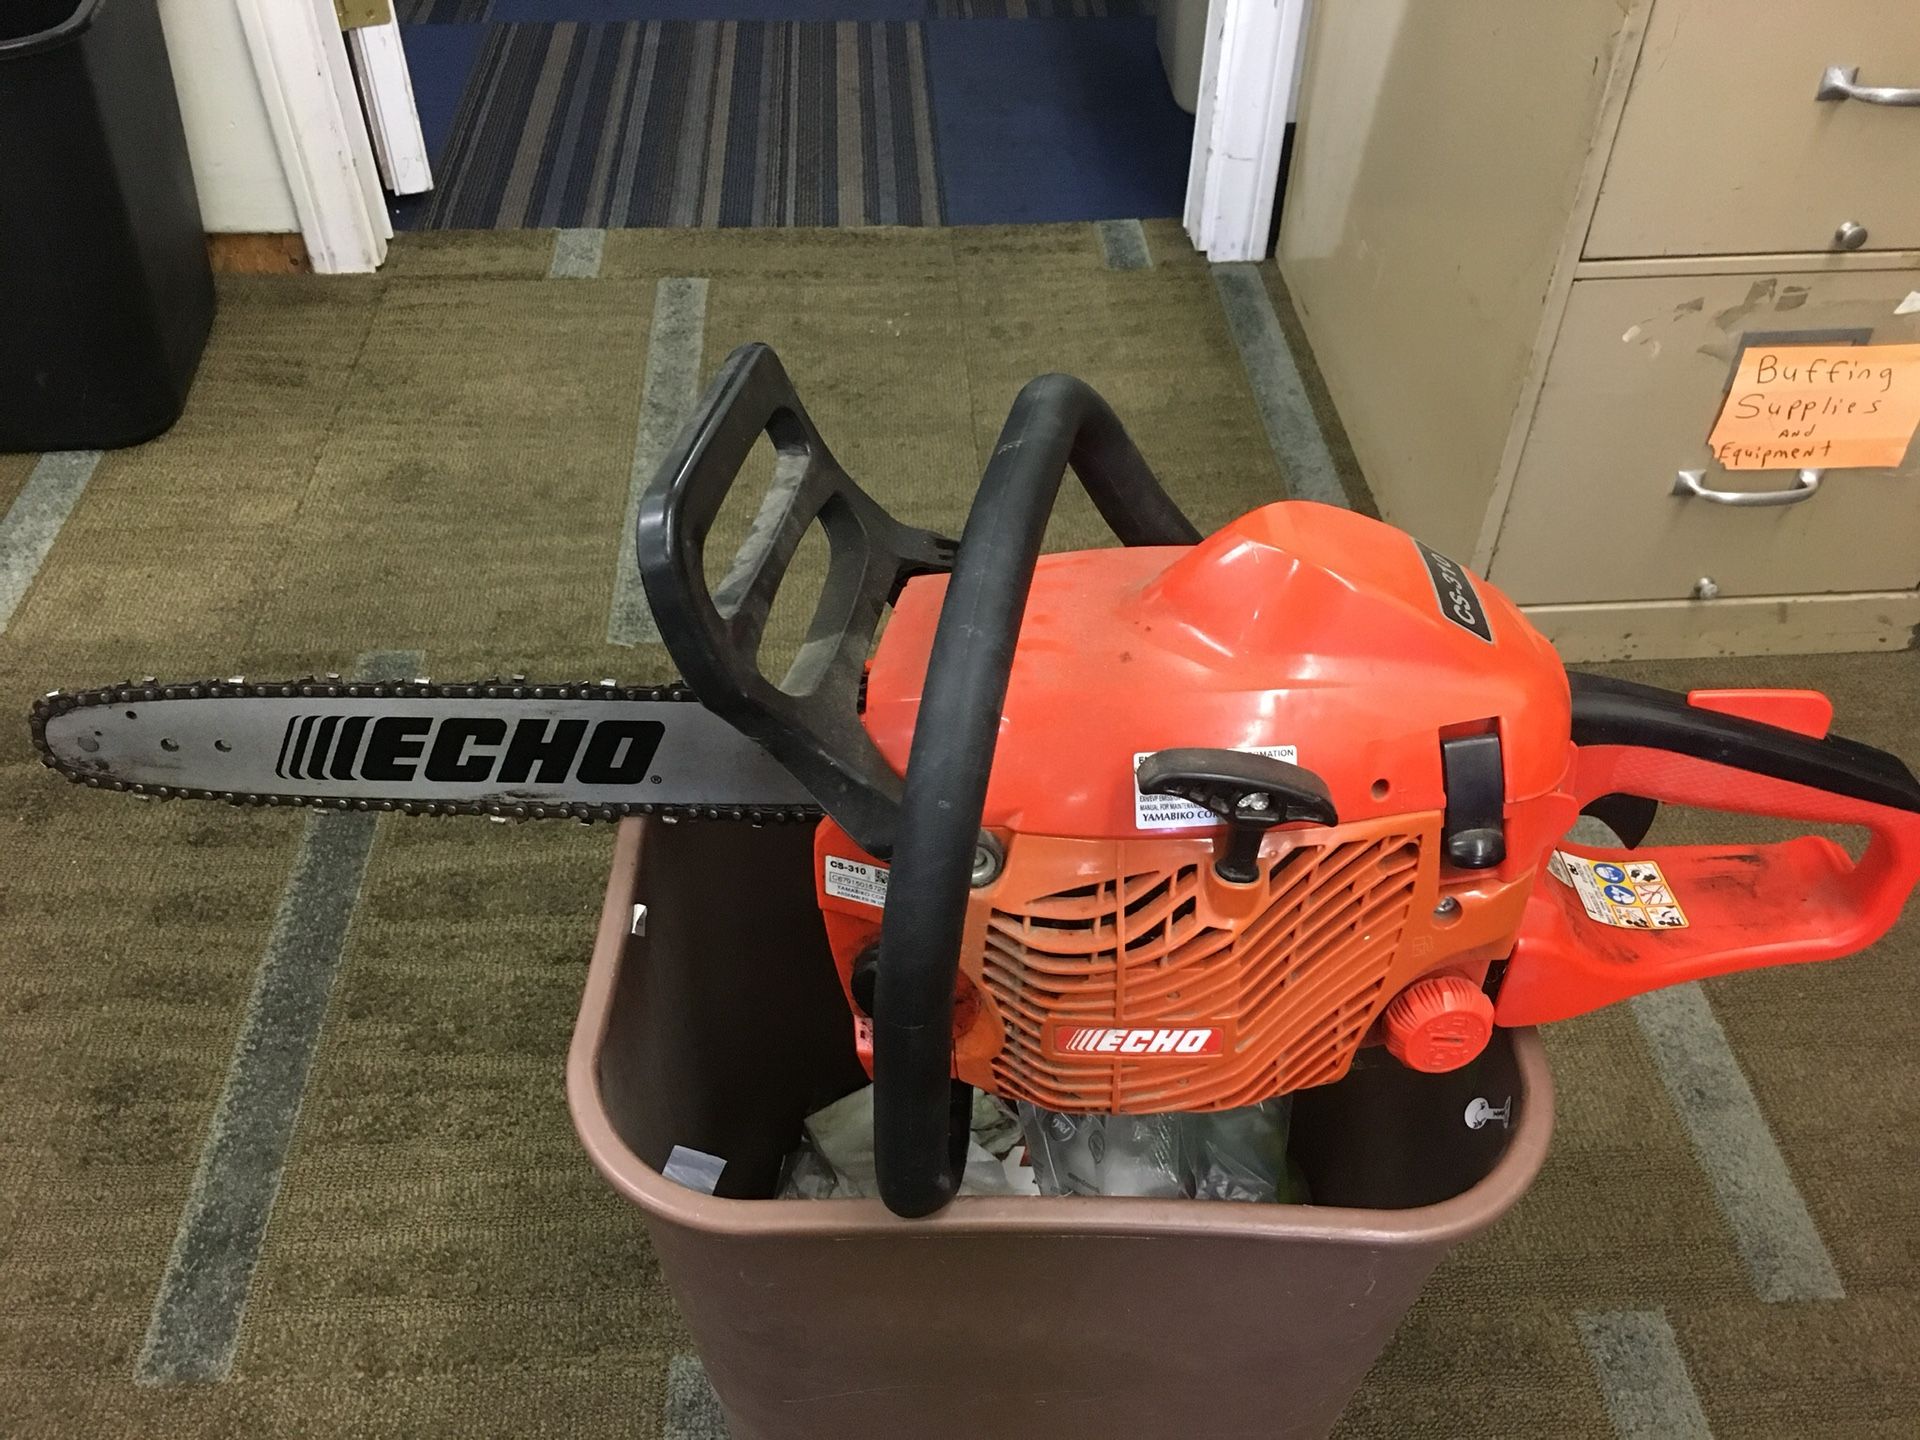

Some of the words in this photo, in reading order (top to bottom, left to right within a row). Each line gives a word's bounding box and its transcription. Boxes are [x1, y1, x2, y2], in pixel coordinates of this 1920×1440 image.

[1757, 354, 1892, 392] Buffing
[1735, 393, 1882, 421] Supplies
[1431, 552, 1475, 625] CS-310
[360, 716, 666, 784] ECHO
[1143, 811, 1194, 822] YAMABIKO
[830, 860, 866, 875] CS-310
[1096, 1029, 1212, 1053] ECHO
